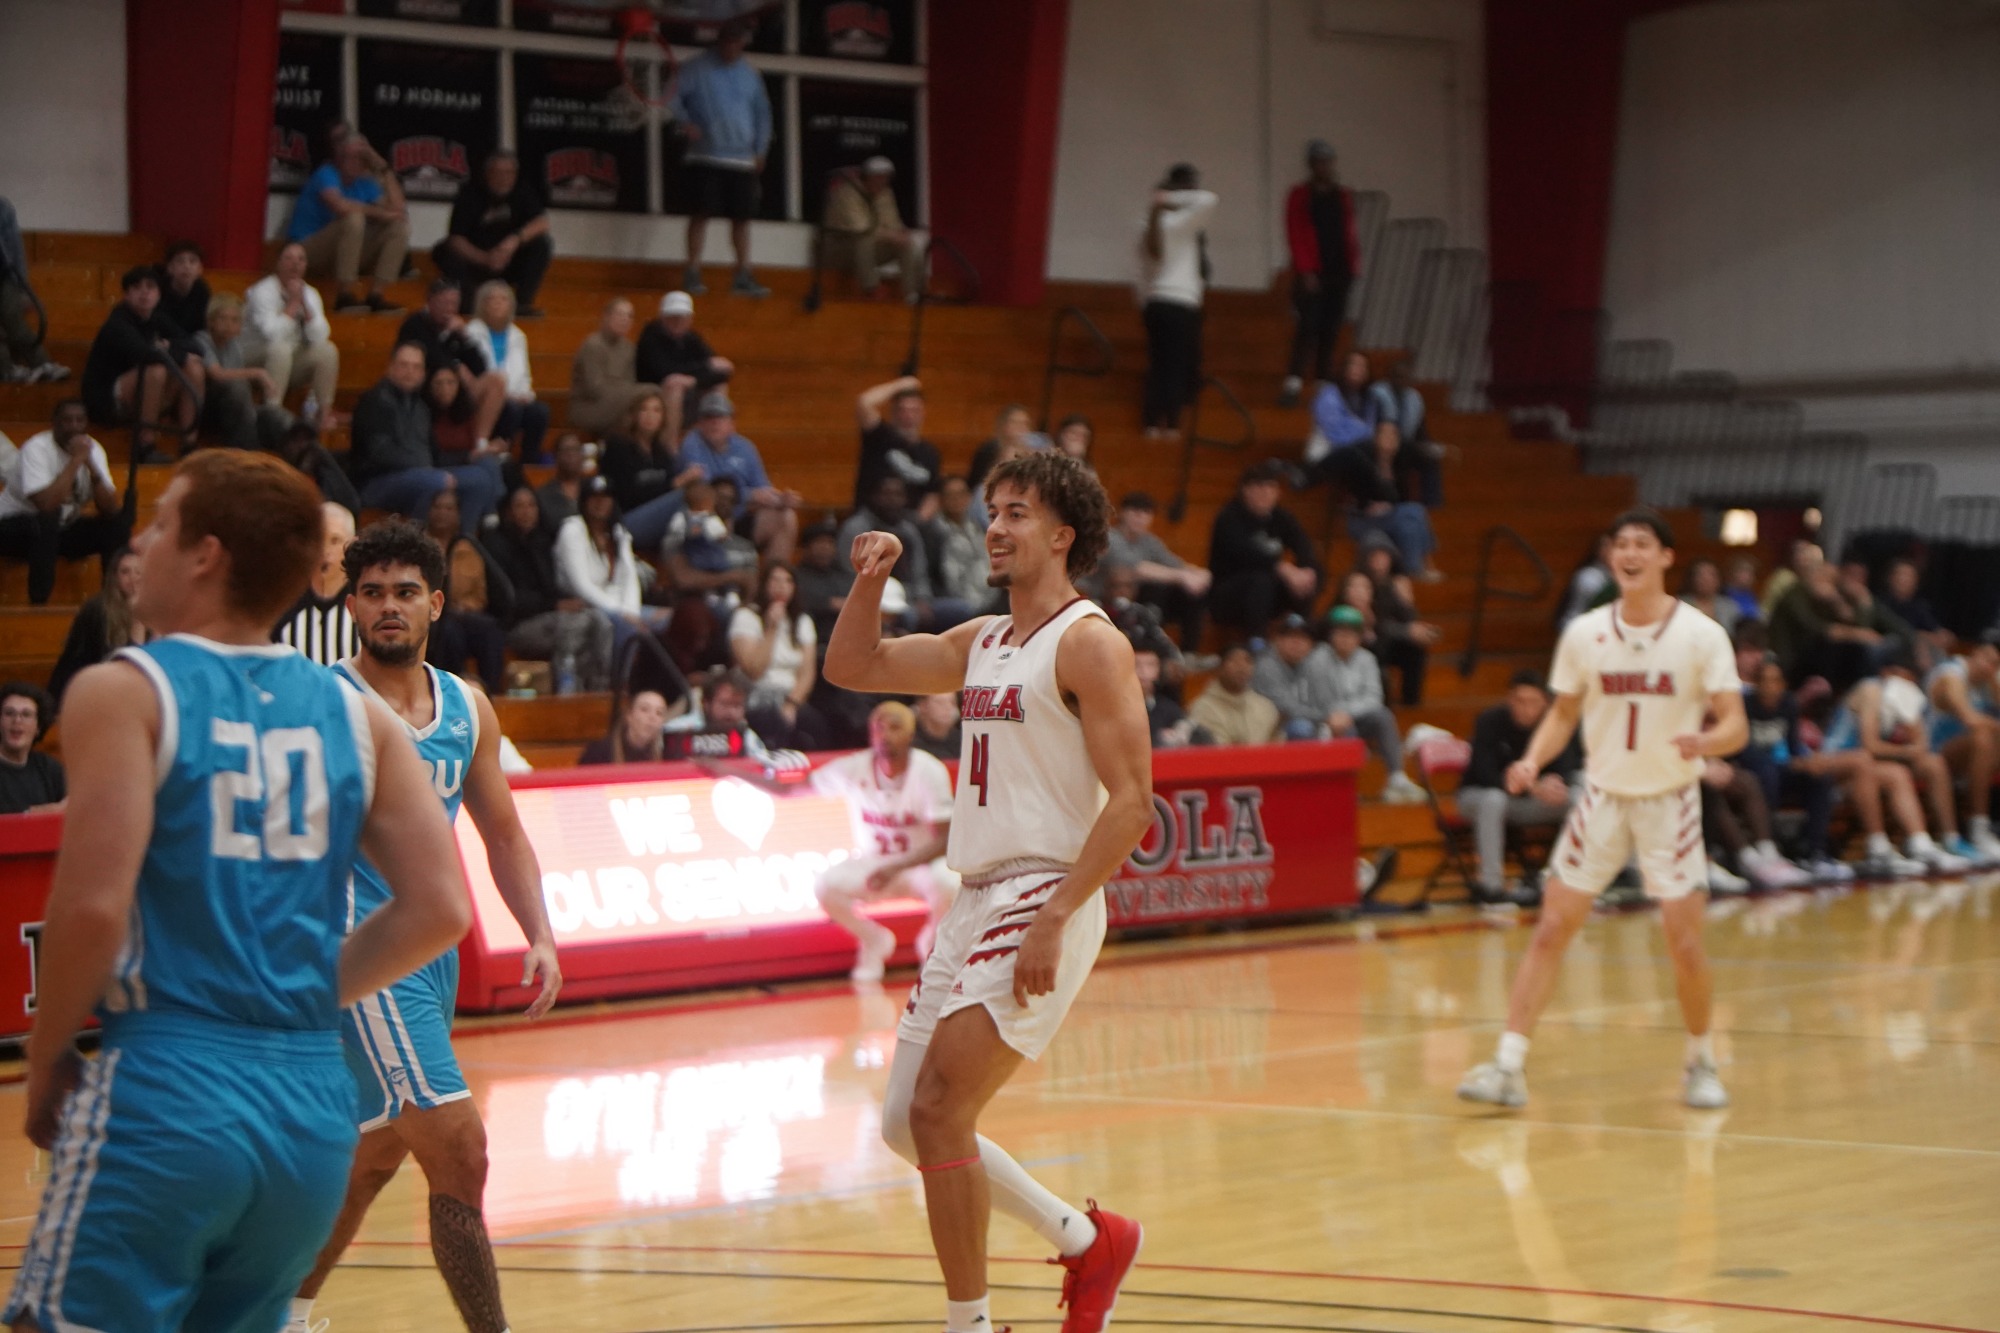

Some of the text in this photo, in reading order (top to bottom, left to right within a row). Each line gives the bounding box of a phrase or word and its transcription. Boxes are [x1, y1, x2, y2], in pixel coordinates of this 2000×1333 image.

[274, 88, 323, 110] UIST
[277, 65, 310, 84] AVE
[375, 83, 482, 110] ED NORMAN
[1626, 701, 1640, 751] 1
[210, 716, 330, 862] 20
[970, 733, 990, 806] 4
[609, 794, 703, 857] WE
[1120, 784, 1276, 876] OLA
[543, 849, 849, 932] OUR SENIOR
[1104, 866, 1275, 919] VERSITY
